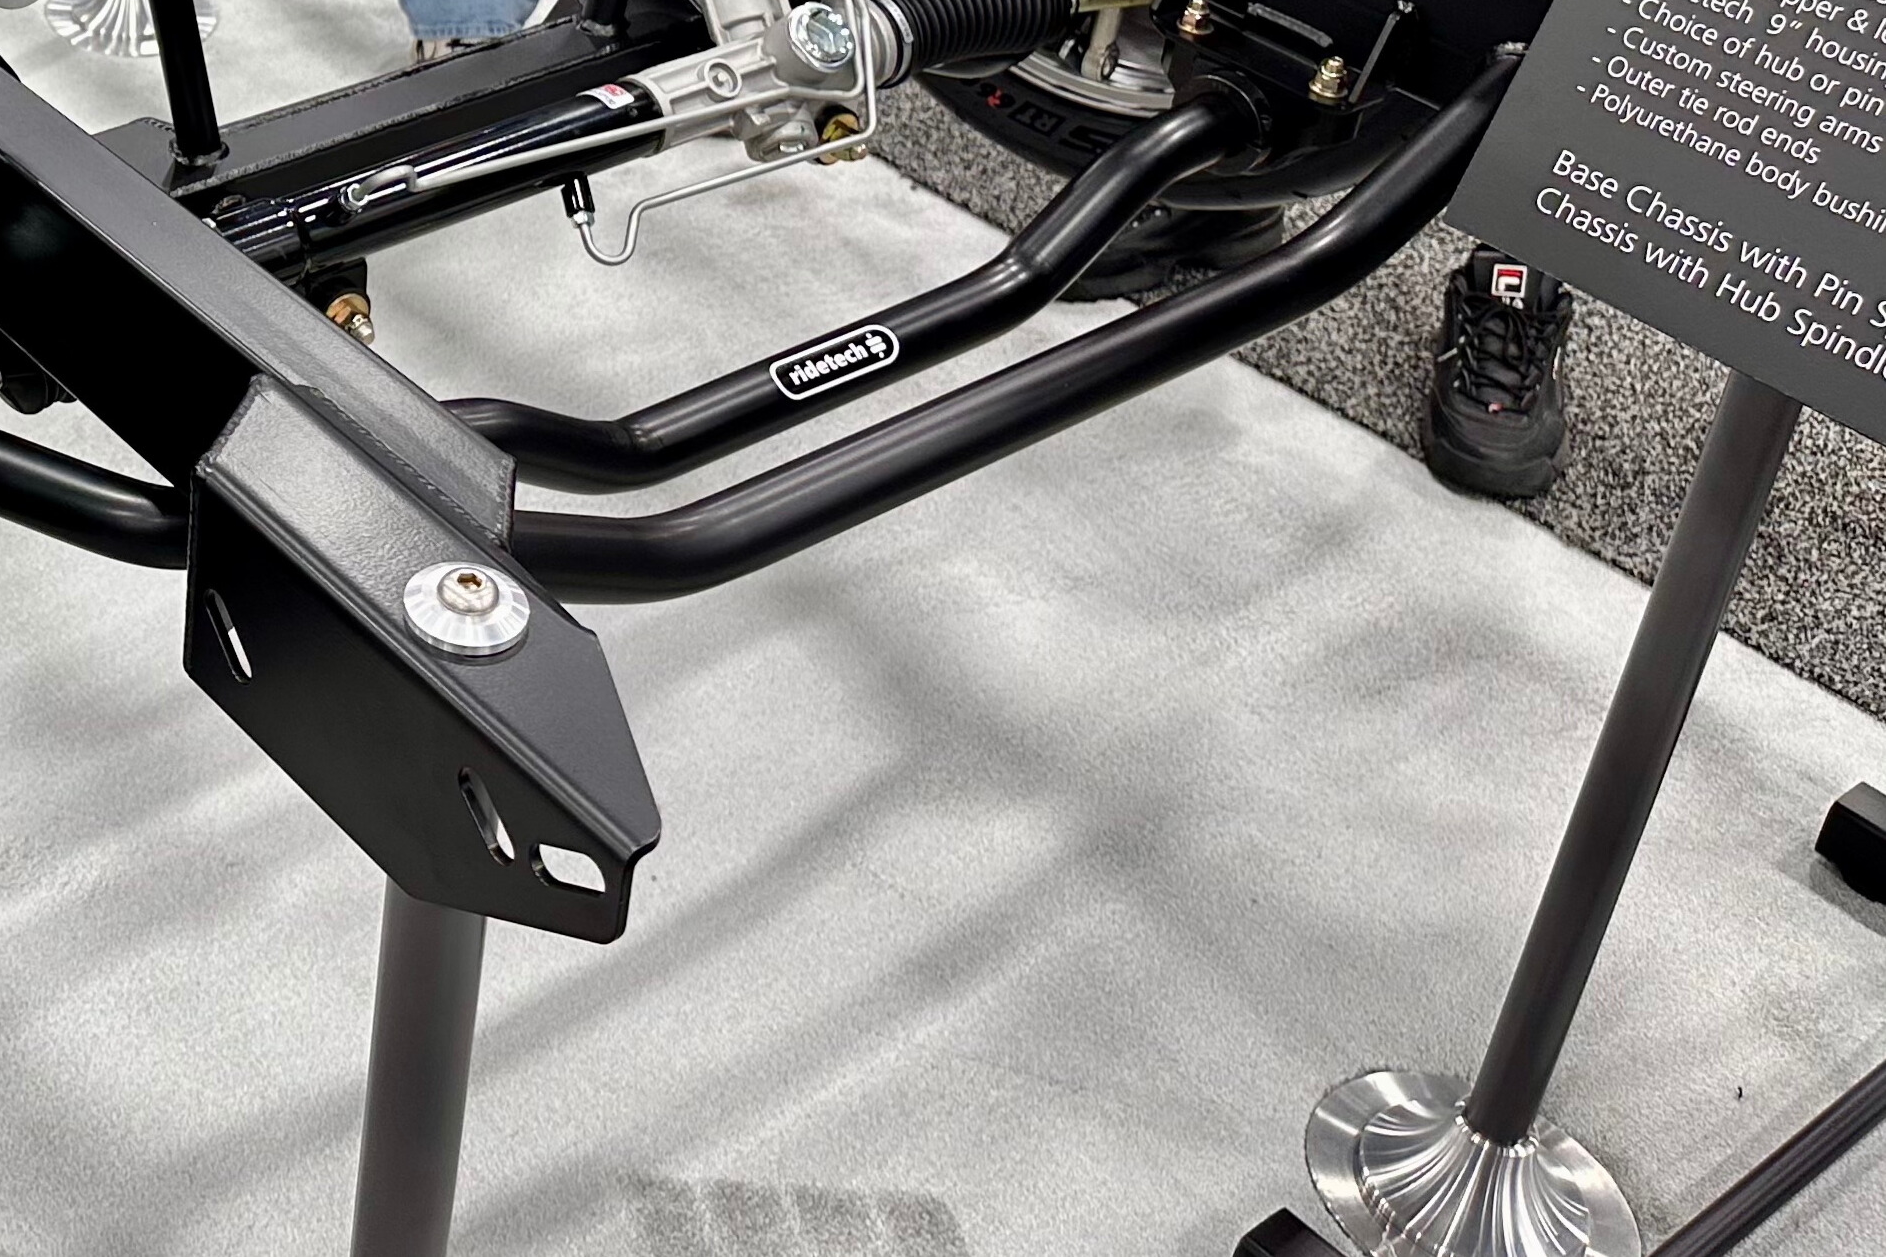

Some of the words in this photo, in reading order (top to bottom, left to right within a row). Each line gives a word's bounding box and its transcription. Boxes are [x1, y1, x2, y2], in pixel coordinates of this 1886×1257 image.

[1723, 37, 1756, 59] of
[1754, 43, 1805, 82] hub
[1809, 73, 1841, 95] or
[1839, 86, 1885, 116] pin
[1846, 8, 1869, 34] &
[1590, 83, 1741, 167] Polyurethane
[1745, 151, 1811, 200] body
[1607, 55, 1676, 98] Outer
[1678, 87, 1709, 116] tie
[1713, 106, 1760, 136] rod
[1760, 127, 1821, 164] ends
[1623, 26, 1713, 81] Custom
[1715, 71, 1816, 128] steering
[1819, 115, 1884, 153] arms
[1536, 187, 1639, 253] Chassis
[1645, 241, 1709, 289] with
[1715, 272, 1781, 322] Hub
[1552, 149, 1619, 199] Base
[1626, 185, 1734, 252] Chassis
[1740, 241, 1807, 289] with
[1813, 272, 1864, 315] Pin
[788, 342, 870, 386] ridetech
